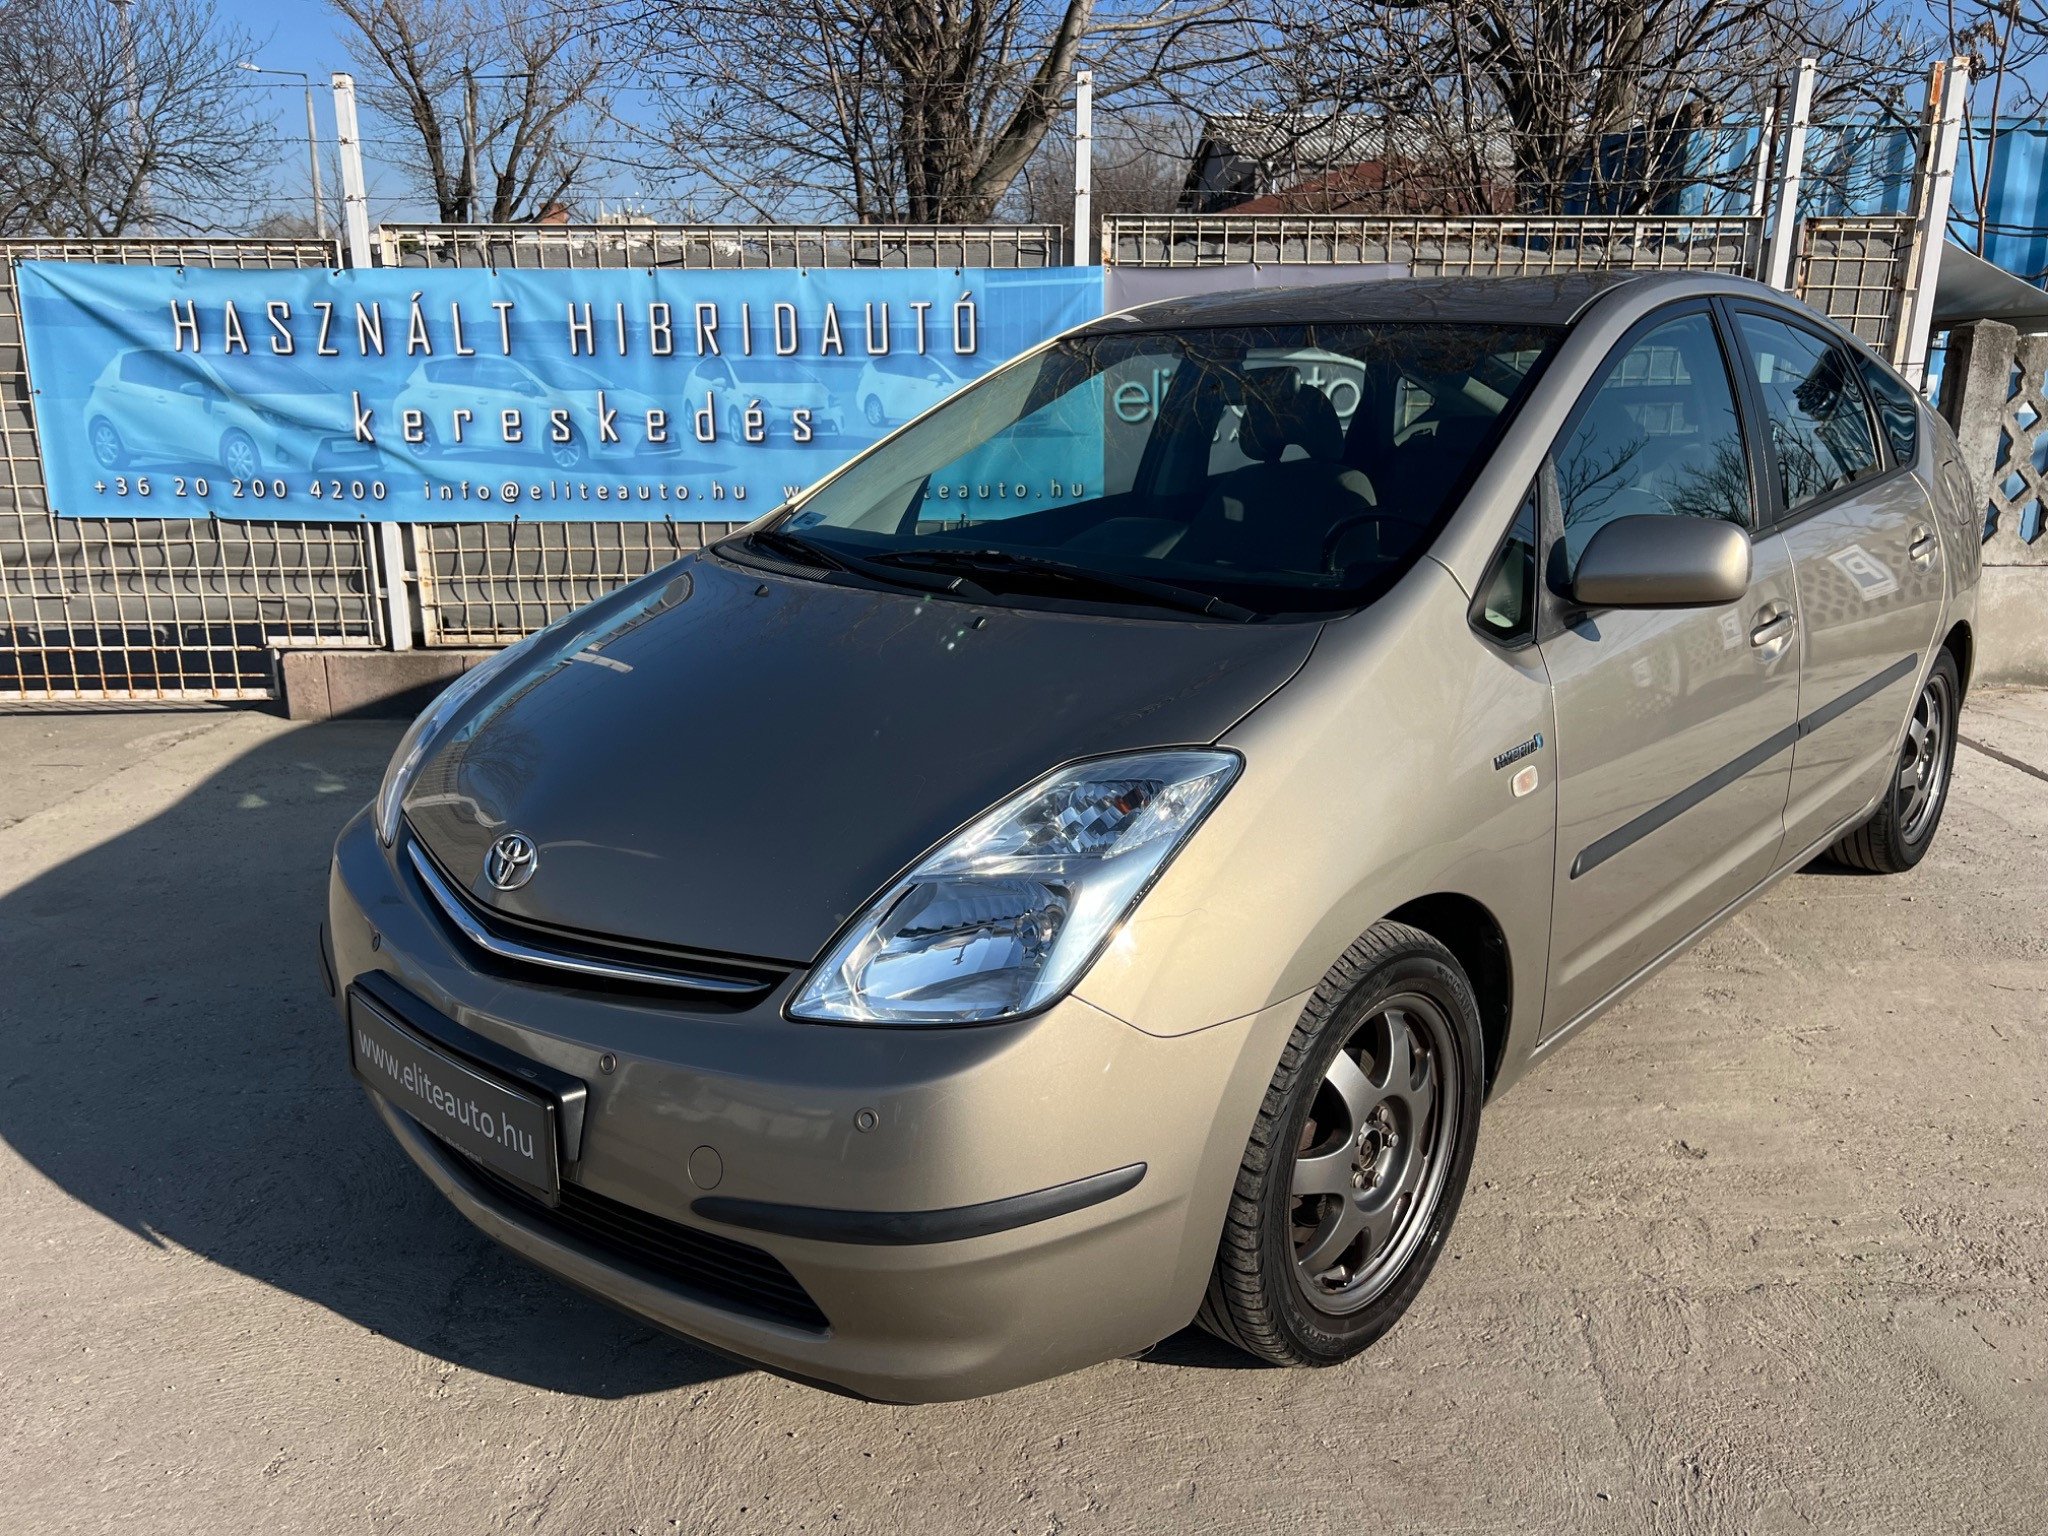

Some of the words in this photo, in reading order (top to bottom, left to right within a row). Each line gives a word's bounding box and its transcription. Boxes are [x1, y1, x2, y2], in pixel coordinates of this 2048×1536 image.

[169, 291, 516, 356] HASZNÁLT
[567, 291, 979, 356] HIBRIDAUTÓ
[351, 391, 813, 443] kereskedés
[94, 477, 150, 496] +36
[173, 477, 209, 497] 20
[231, 478, 287, 498] 200
[309, 480, 386, 500] 4200
[424, 480, 747, 502] info@eliteauto.hu
[357, 1029, 535, 1160] www.eliteauto.hu
